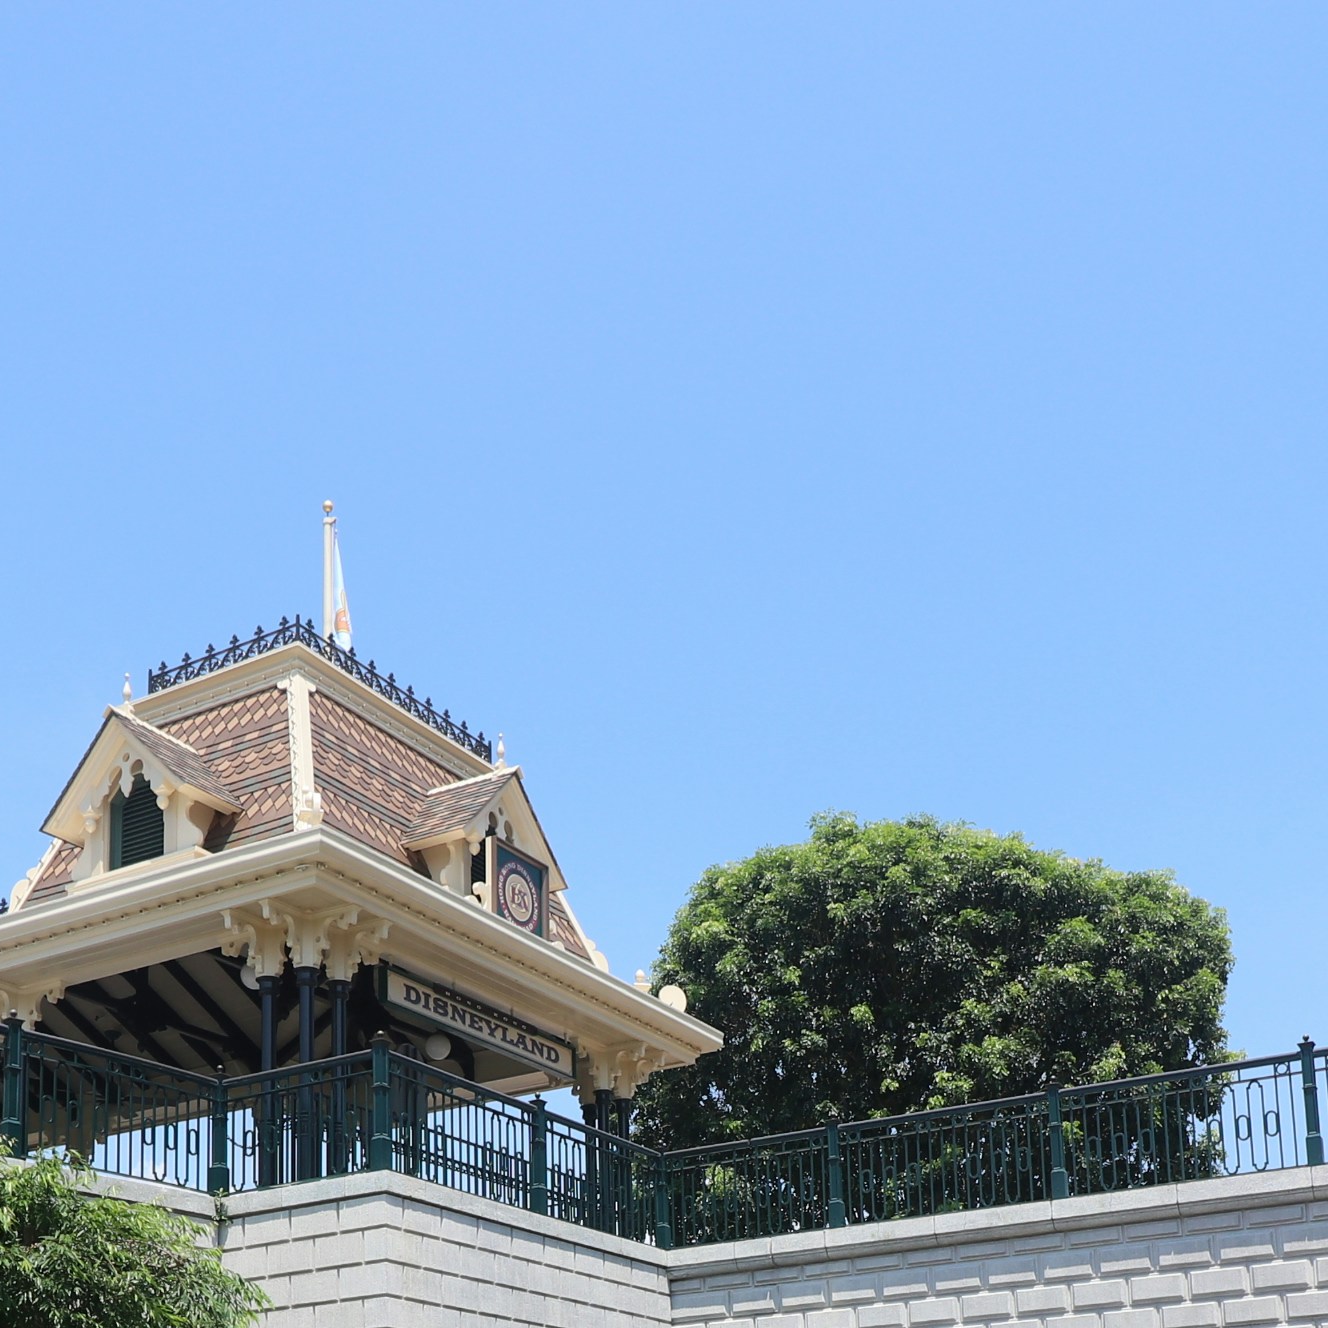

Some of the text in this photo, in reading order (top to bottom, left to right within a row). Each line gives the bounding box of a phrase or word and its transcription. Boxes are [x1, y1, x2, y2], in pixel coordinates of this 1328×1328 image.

[403, 983, 560, 1063] DISNEYLAND
[445, 991, 527, 1030] HONG KONG
